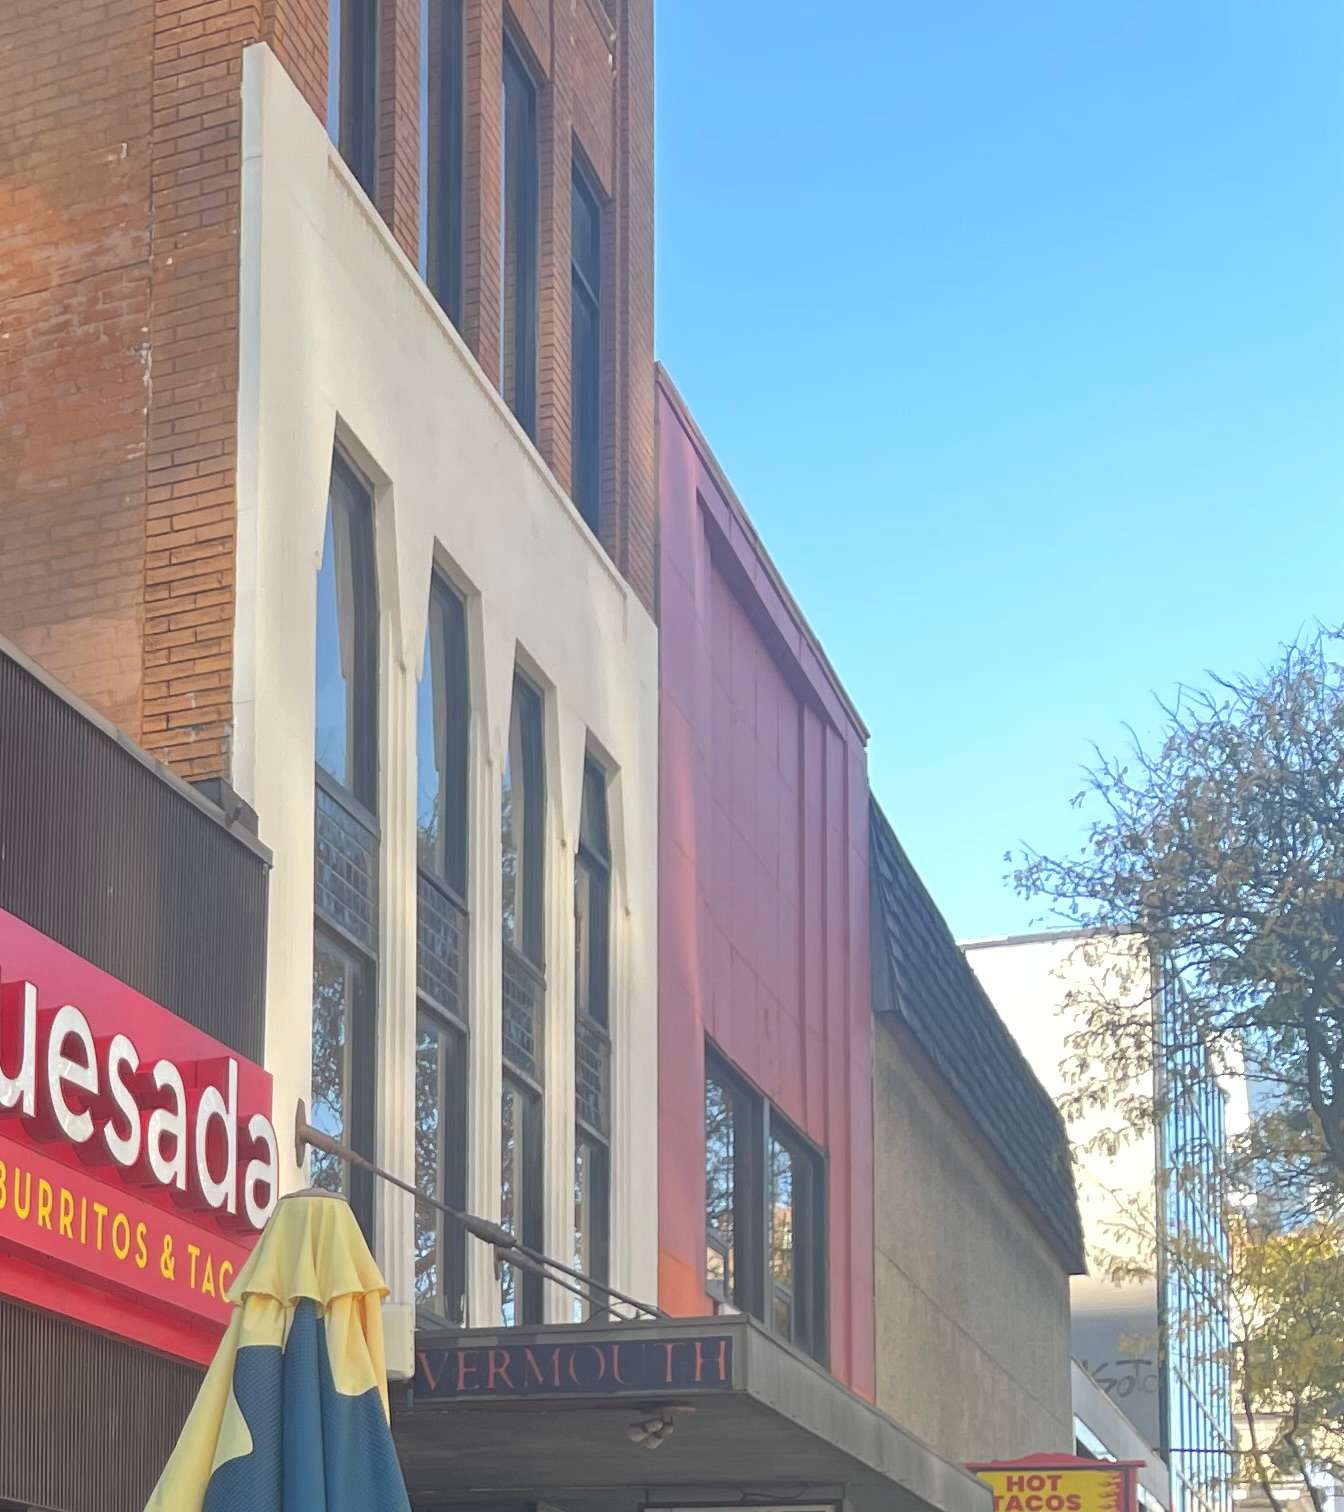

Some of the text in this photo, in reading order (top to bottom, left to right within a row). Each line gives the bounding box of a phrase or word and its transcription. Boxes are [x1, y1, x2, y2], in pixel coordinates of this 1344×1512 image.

[161, 1234, 175, 1280] &
[188, 1244, 233, 1303] TAC
[416, 1340, 728, 1392] VERMOUTH
[1006, 1474, 1063, 1493] HOT
[993, 1493, 1081, 1512] TACOS
